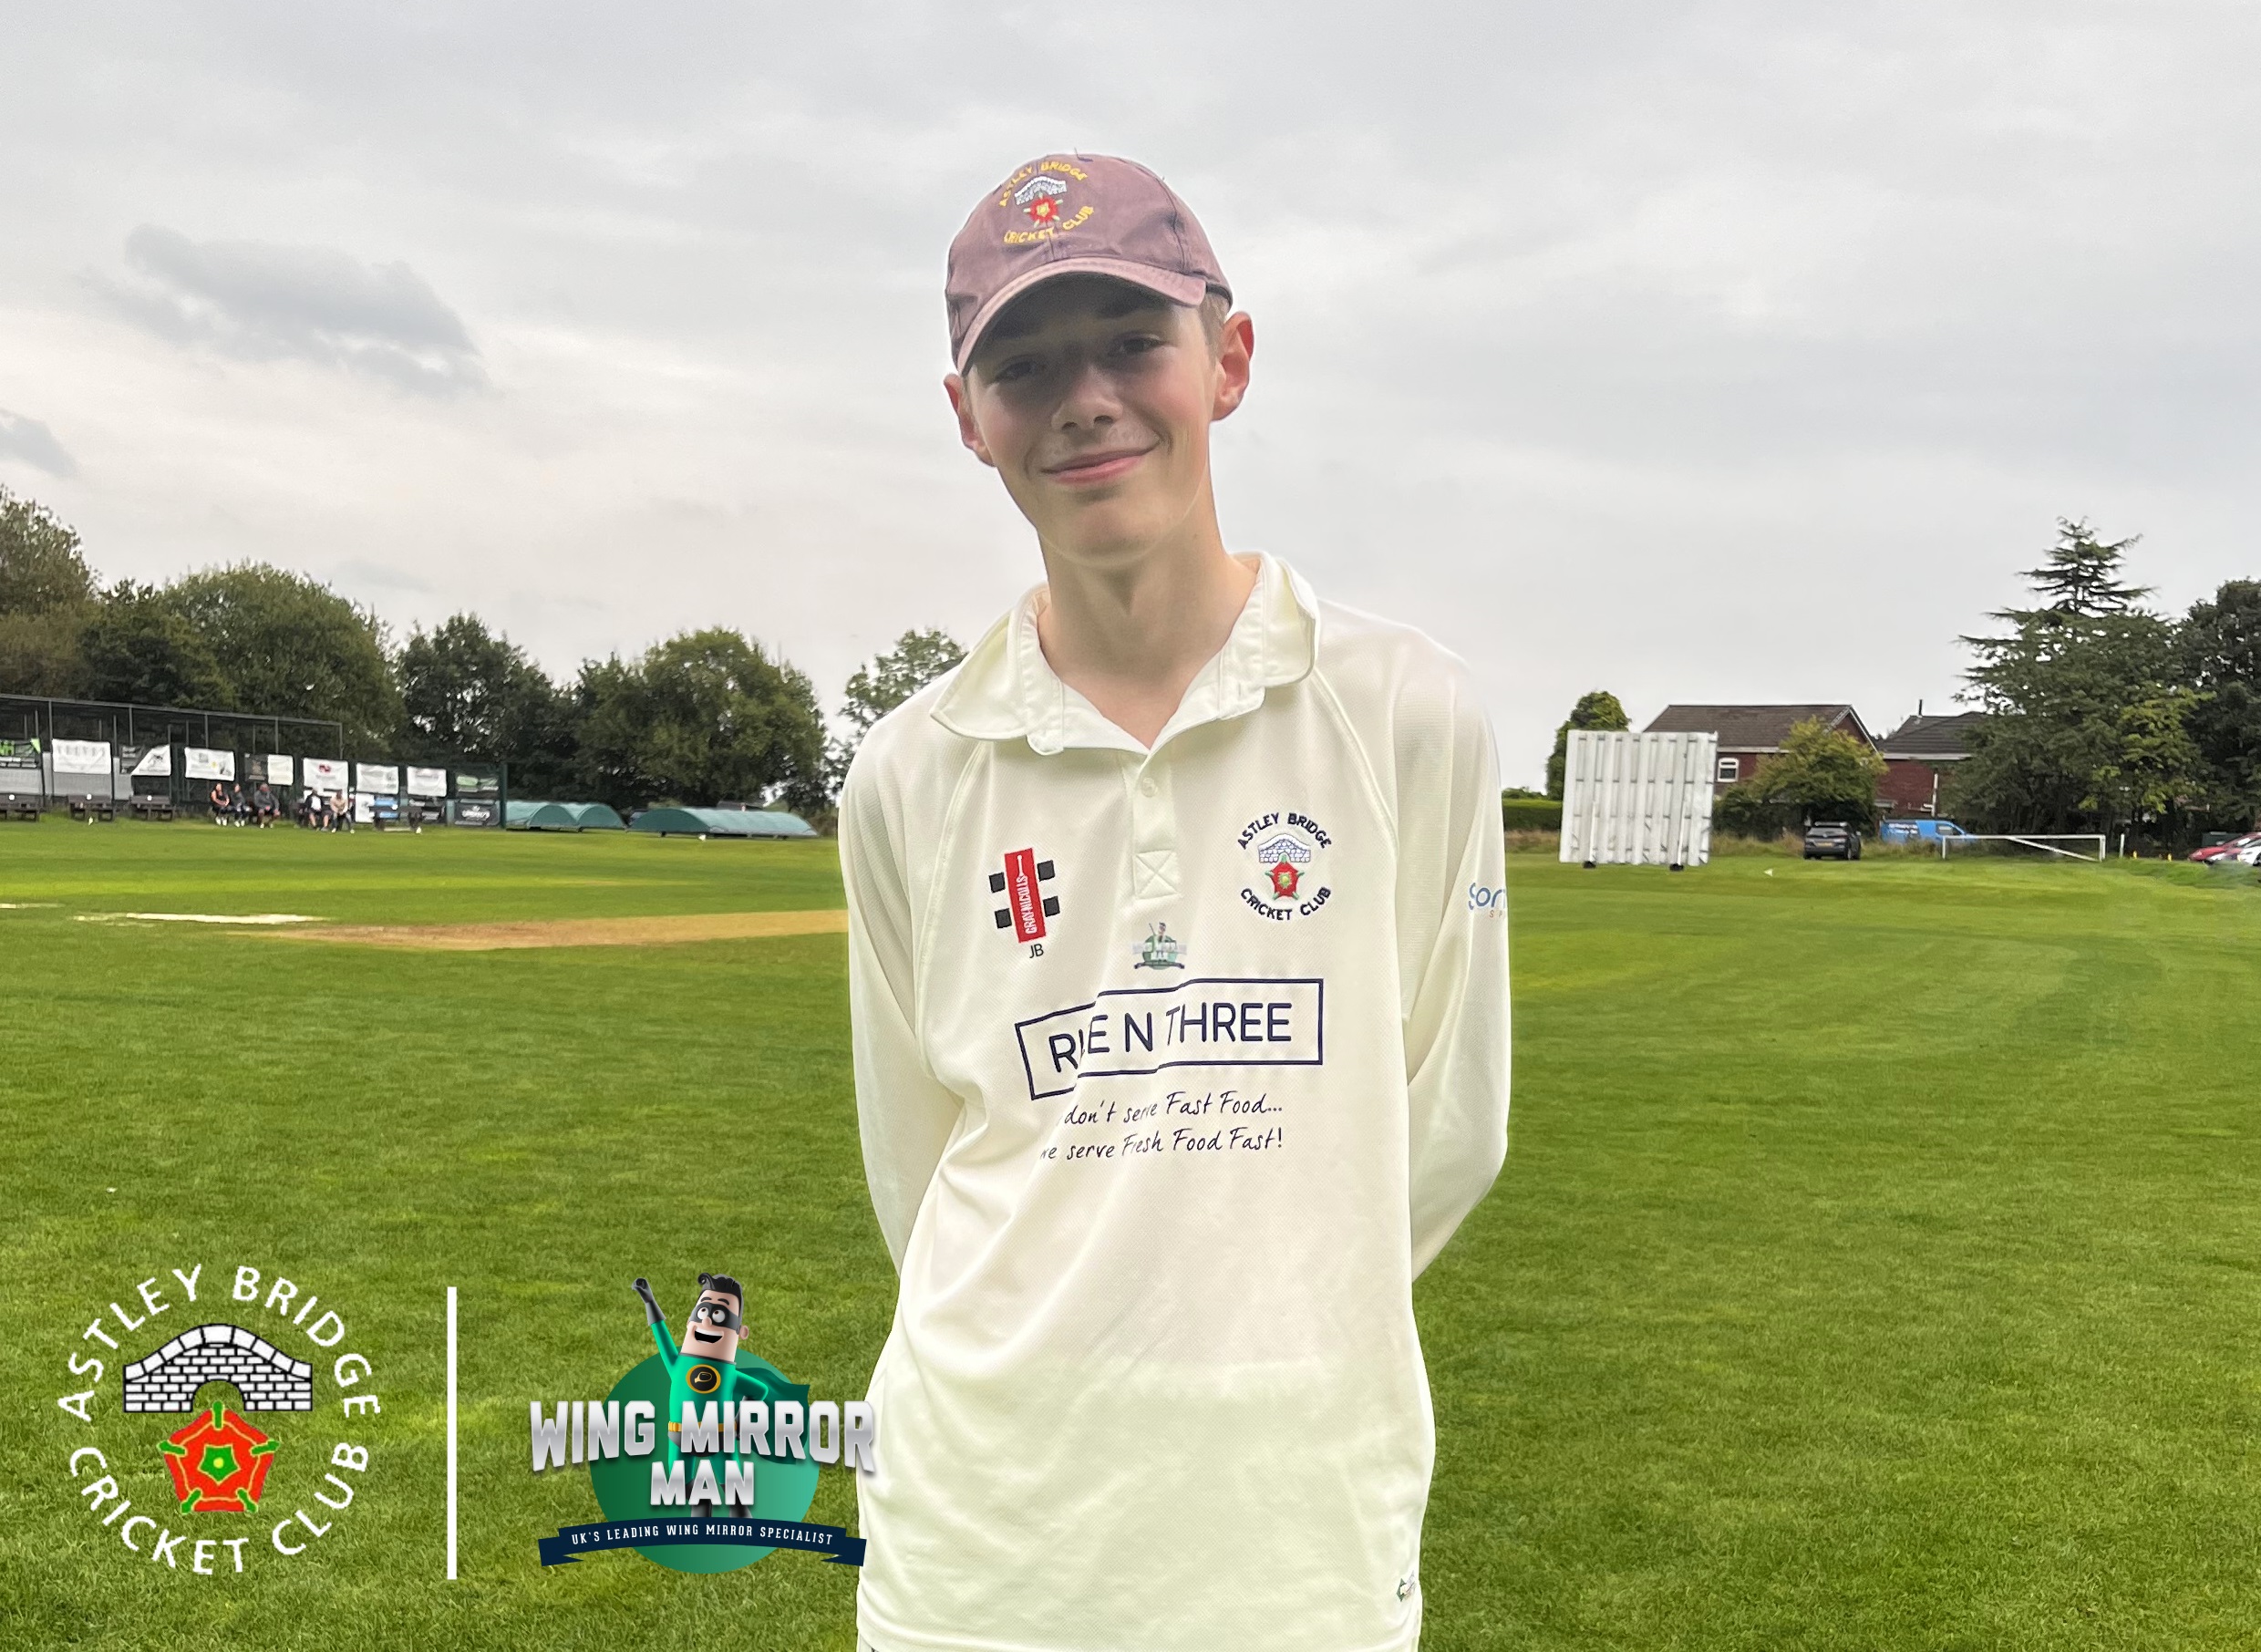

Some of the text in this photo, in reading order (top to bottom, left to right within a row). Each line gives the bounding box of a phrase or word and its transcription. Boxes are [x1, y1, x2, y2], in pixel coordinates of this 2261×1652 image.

[998, 161, 1089, 207] ASTLEY BRIDGE
[1004, 205, 1095, 243] CRICKET CLUB
[1237, 812, 1332, 850] ASTLEY BRIDGE
[1240, 886, 1331, 921] CRICKET CLUB
[1028, 944, 1045, 958] JB
[1124, 1012, 1153, 1052] N
[1166, 1001, 1293, 1046] THREE
[1064, 1100, 1117, 1125] don't
[1166, 1091, 1213, 1115] Fast
[1219, 1090, 1283, 1114] Food...
[1067, 1144, 1115, 1161] serve
[1172, 1128, 1223, 1151] Food
[1229, 1127, 1283, 1151] Fast!
